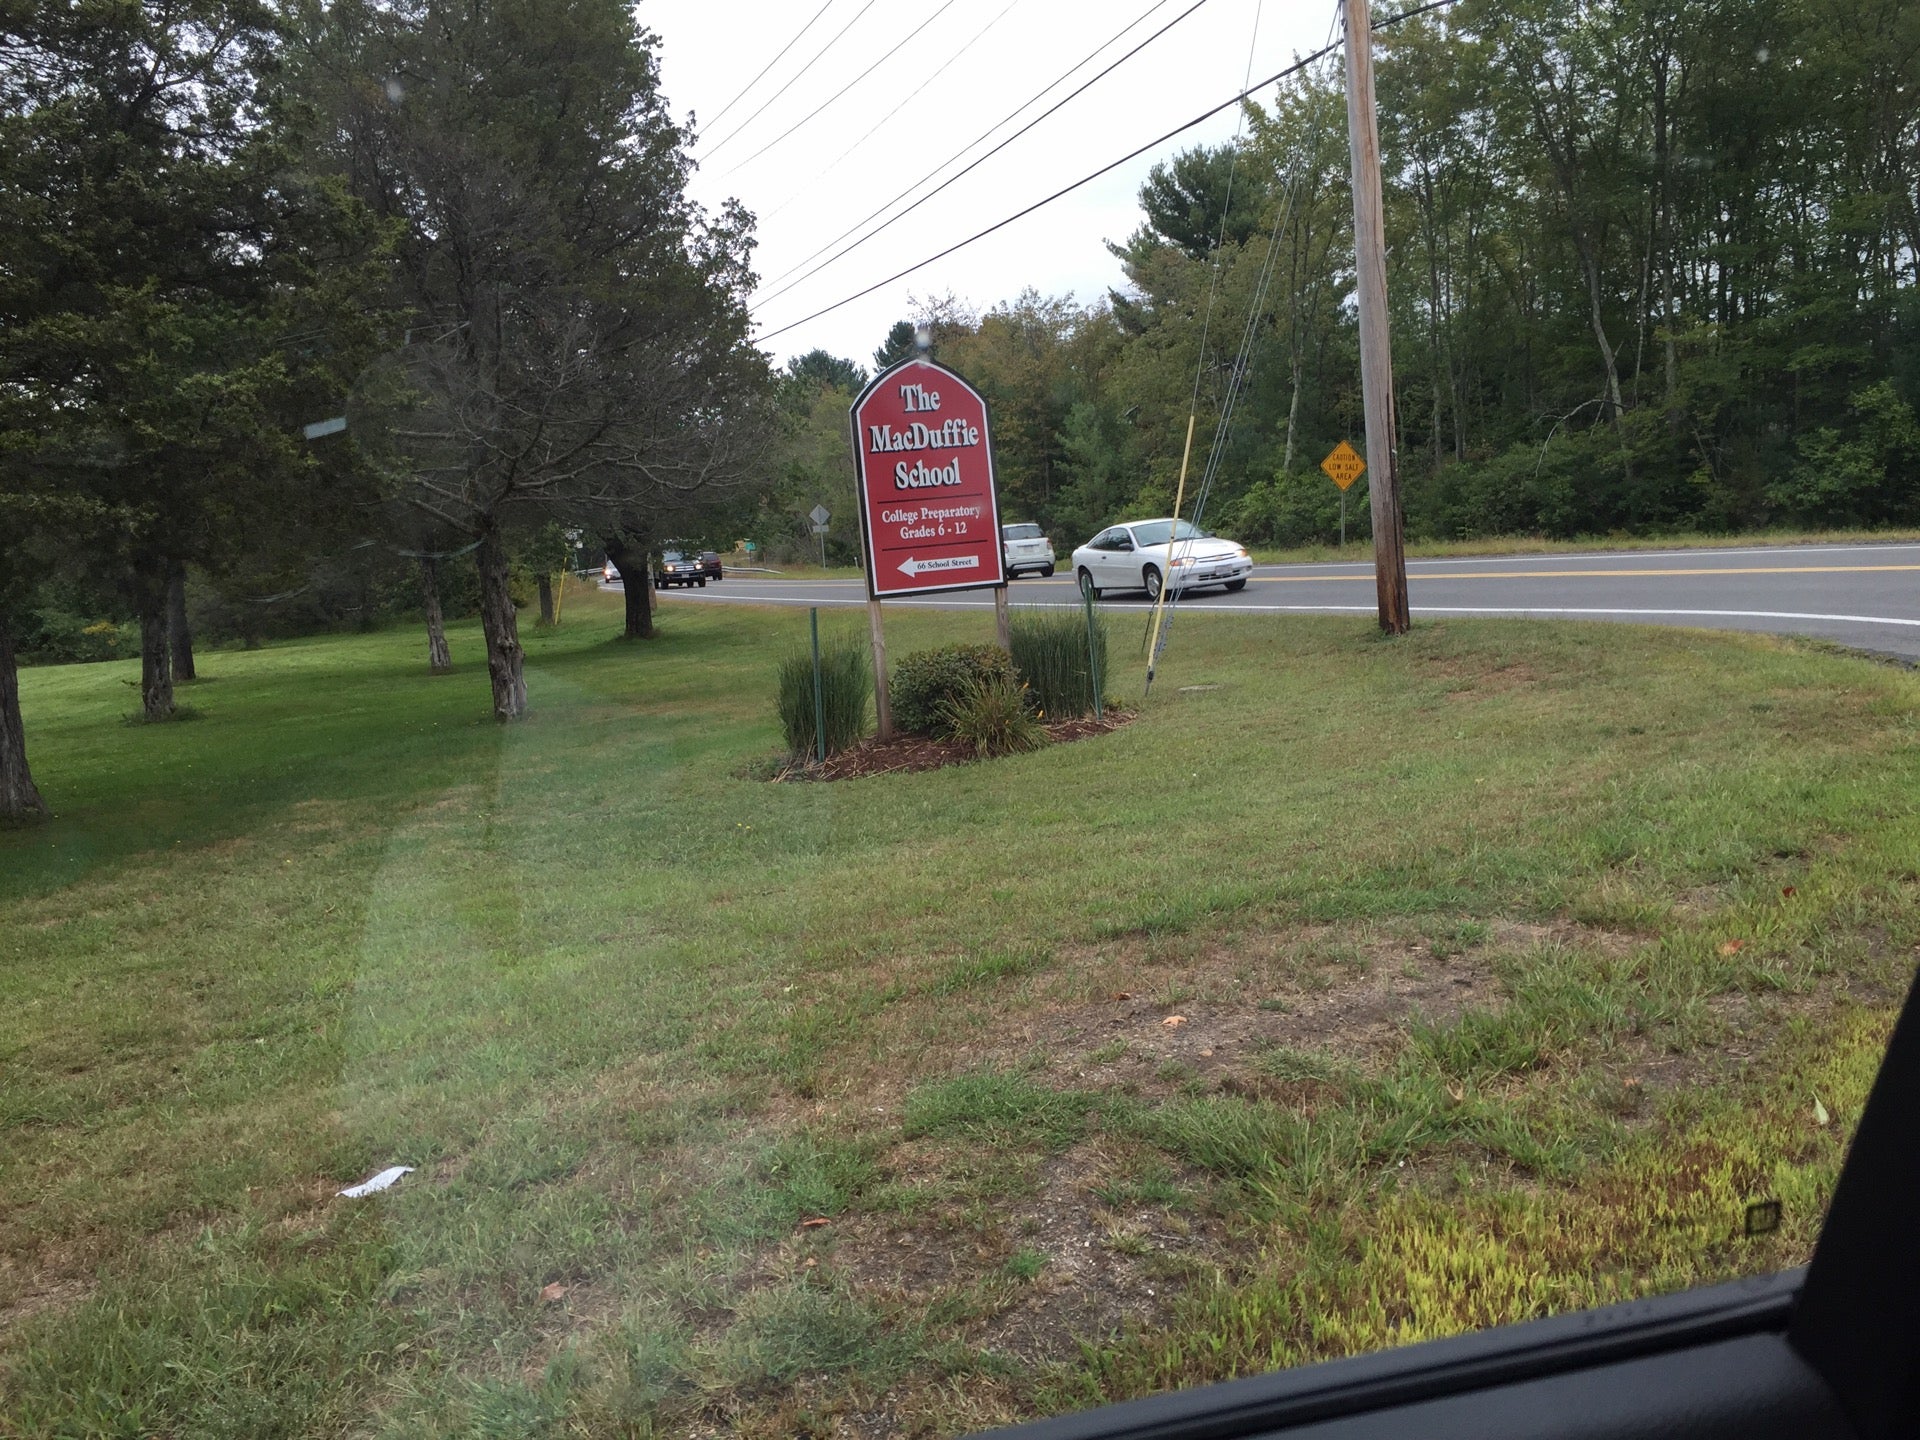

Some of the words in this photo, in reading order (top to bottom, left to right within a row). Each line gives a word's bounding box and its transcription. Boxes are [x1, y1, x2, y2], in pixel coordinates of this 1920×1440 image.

[899, 383, 941, 412] The
[869, 418, 980, 453] MacDuffie
[895, 456, 962, 489] School
[1329, 463, 1341, 471] LOW
[1345, 463, 1358, 471] SALT
[881, 509, 919, 525] College
[920, 505, 981, 522] Preparatory
[900, 525, 935, 539] Grades
[938, 523, 945, 536] 6
[954, 521, 967, 535] 12
[917, 562, 926, 570] 66
[927, 560, 950, 569] School
[951, 558, 972, 567] Street
